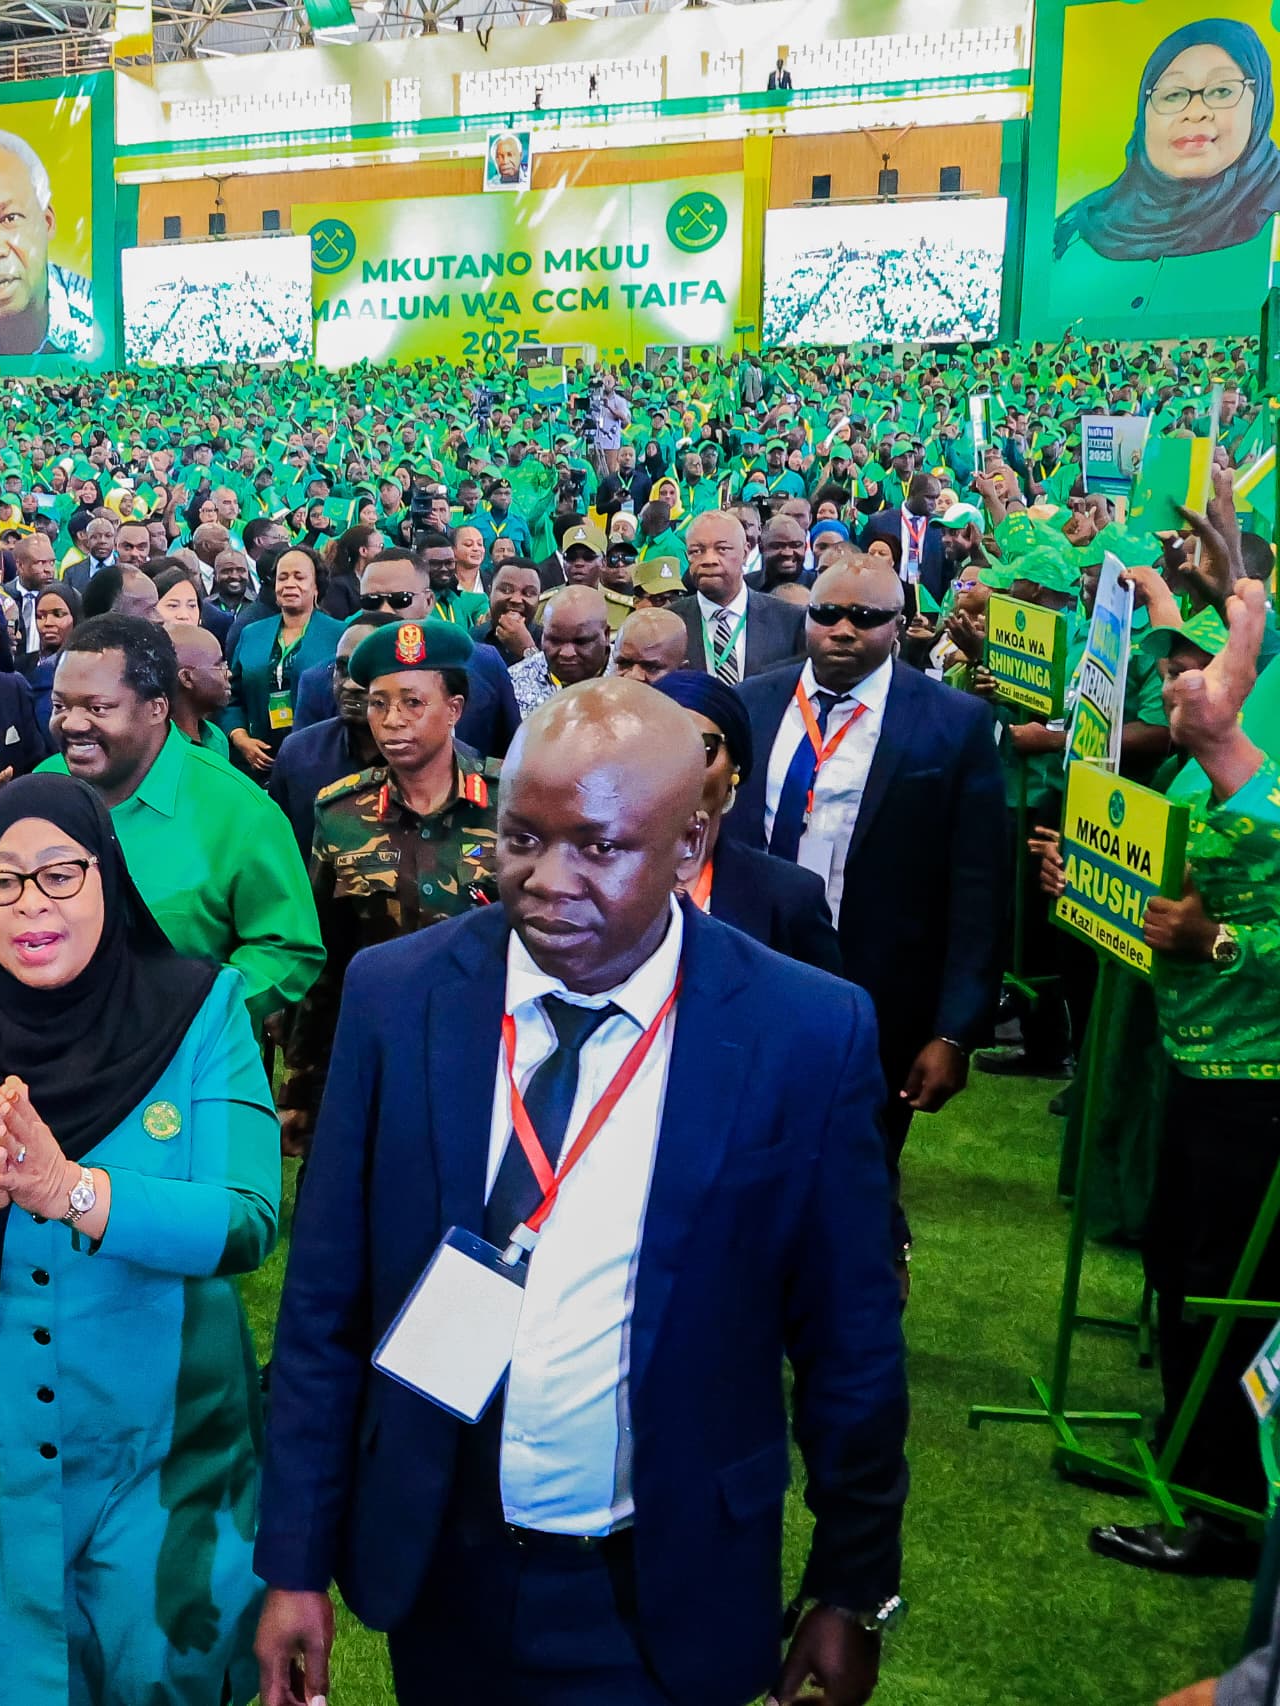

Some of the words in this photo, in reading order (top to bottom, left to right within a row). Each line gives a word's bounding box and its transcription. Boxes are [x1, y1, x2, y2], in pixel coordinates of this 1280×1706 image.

[362, 251, 532, 284] MKUTANO
[544, 244, 649, 274] MKUU
[461, 291, 521, 318] WA
[532, 286, 609, 313] CCM
[620, 279, 727, 309] TAIFA
[462, 329, 540, 356] 2025
[995, 628, 1026, 650] MKOA
[1028, 638, 1046, 657] WA
[988, 649, 1051, 691] SHINYANGA
[1076, 816, 1121, 861] MKOA
[1126, 841, 1151, 878] WA
[1070, 906, 1094, 935] Kazi
